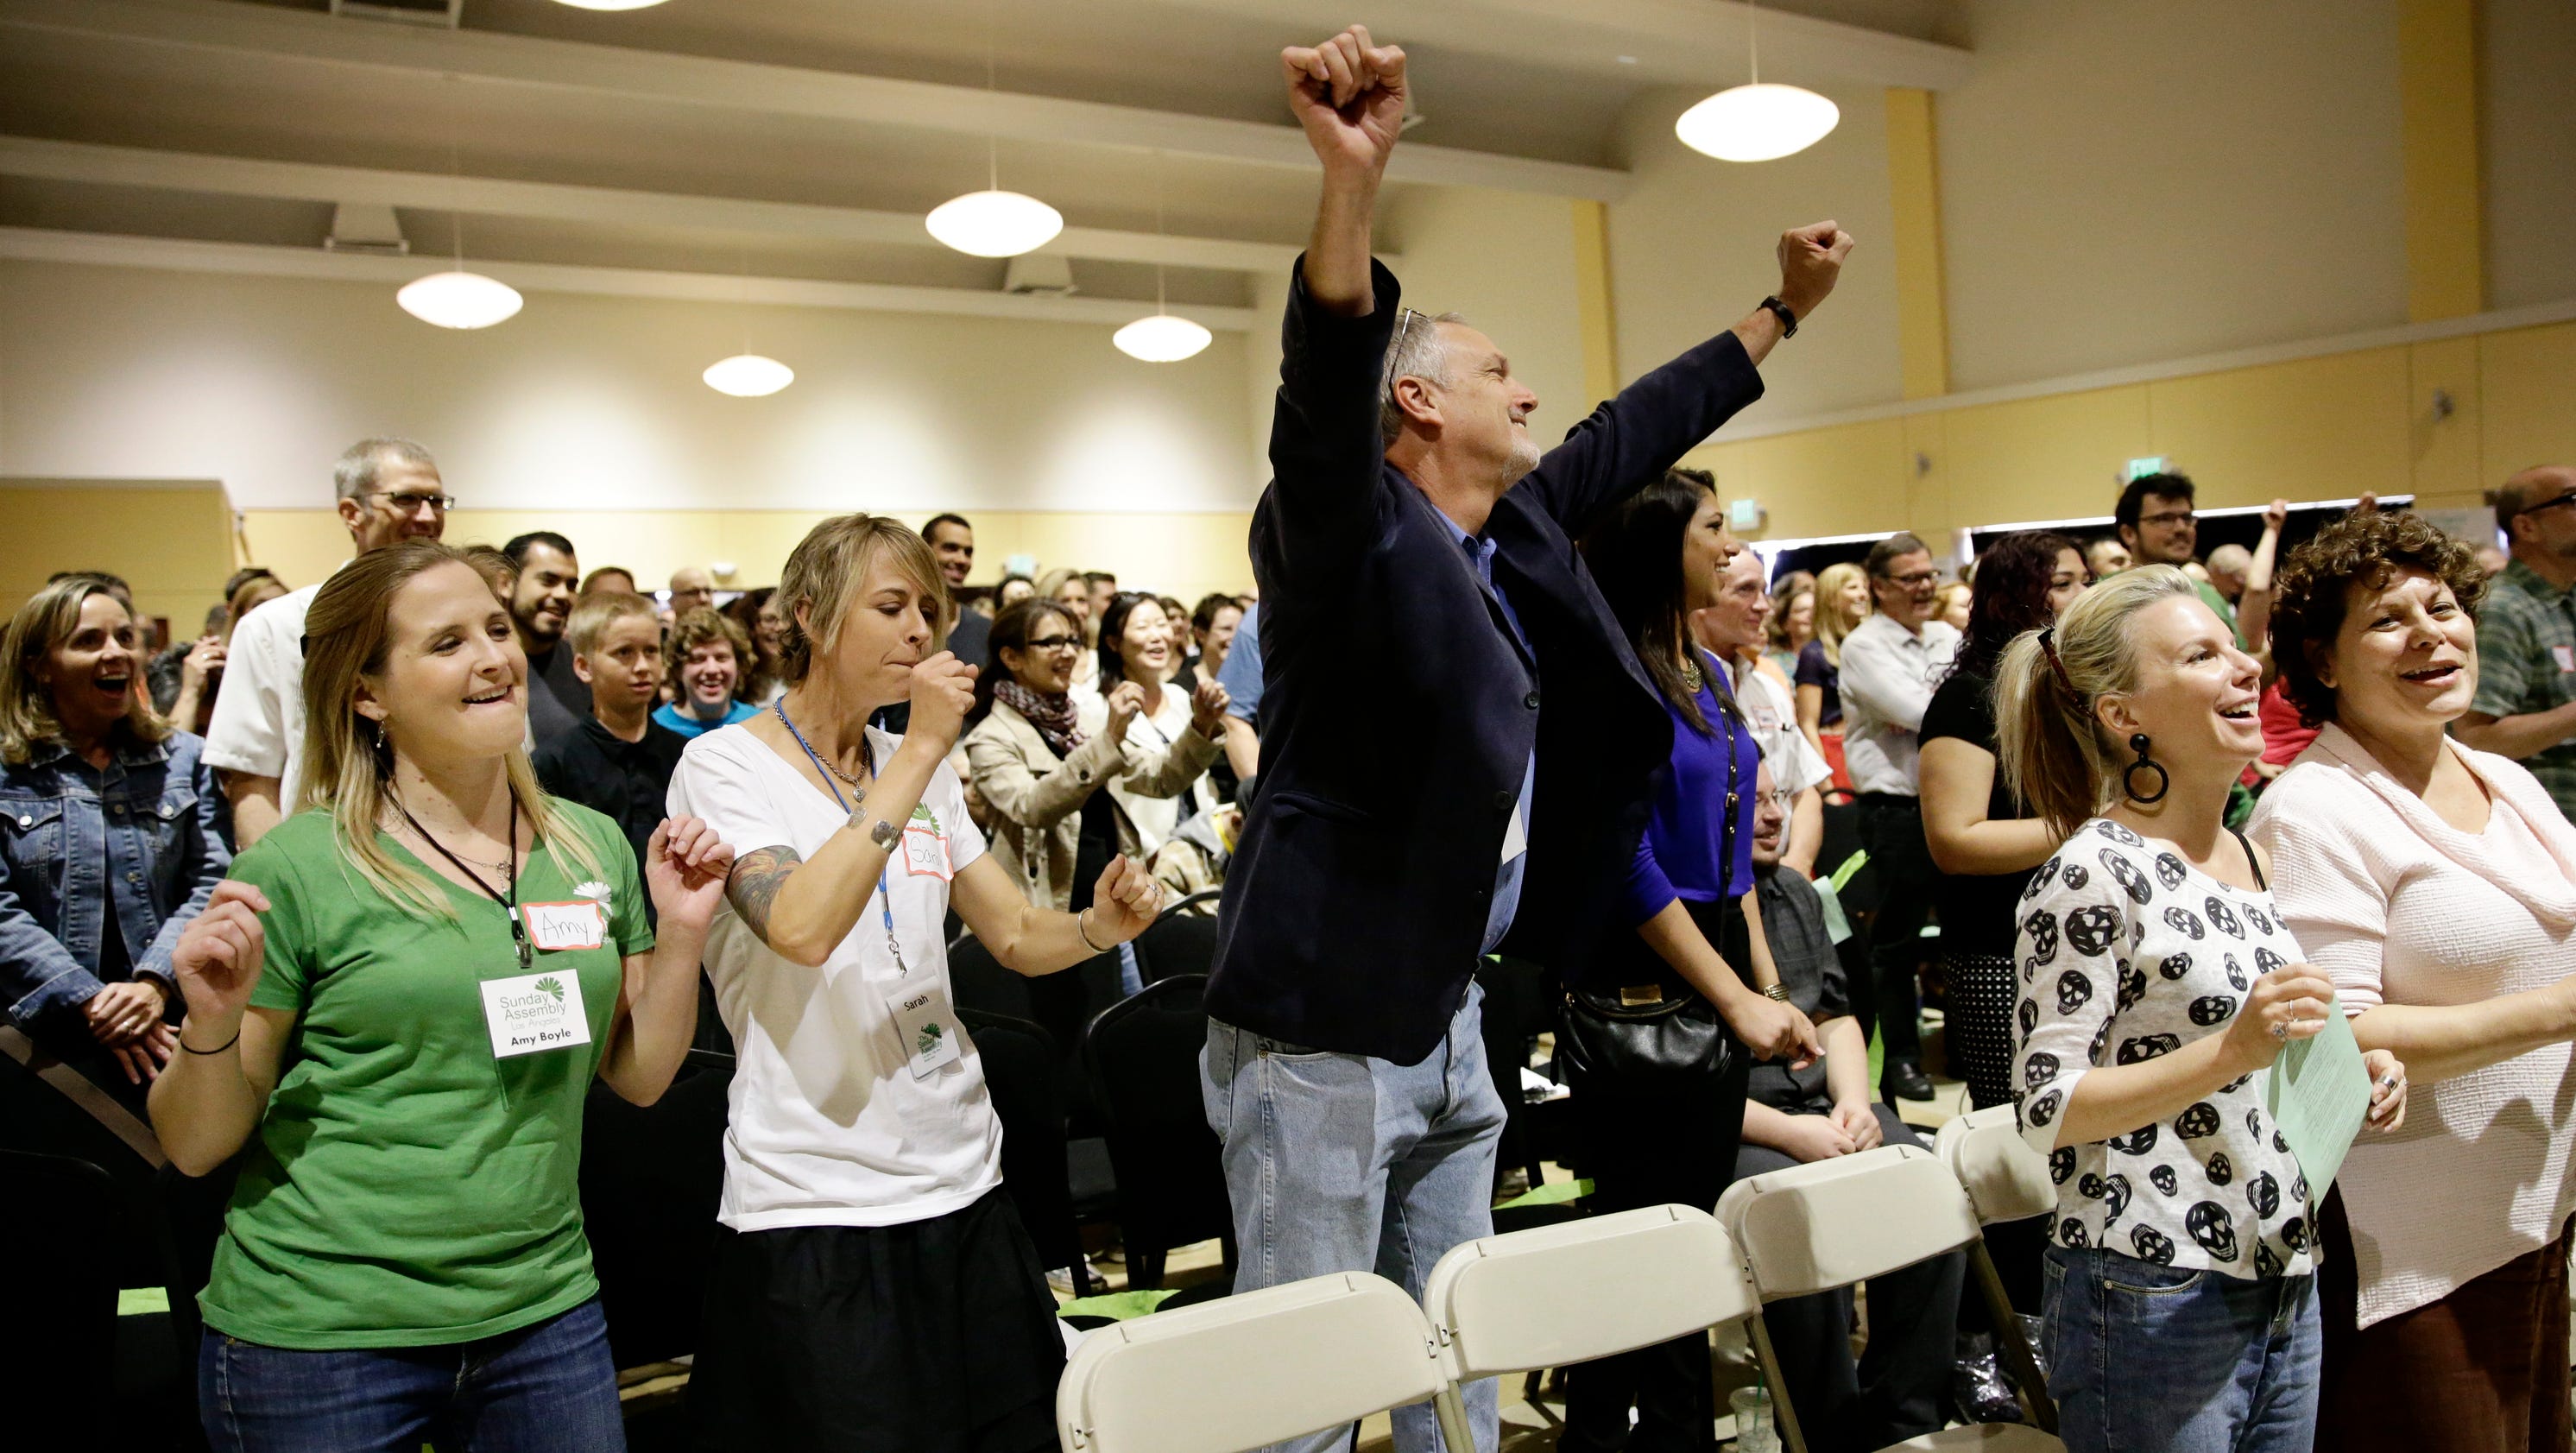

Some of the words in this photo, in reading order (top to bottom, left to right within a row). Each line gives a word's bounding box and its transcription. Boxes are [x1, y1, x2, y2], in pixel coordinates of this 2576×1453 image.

[542, 913, 589, 944] Amy
[499, 993, 549, 1008] Sunday
[904, 995, 929, 1011] Sarah
[504, 1001, 566, 1020] Assembly
[511, 1036, 536, 1046] Amy
[540, 1028, 571, 1042] Boyle
